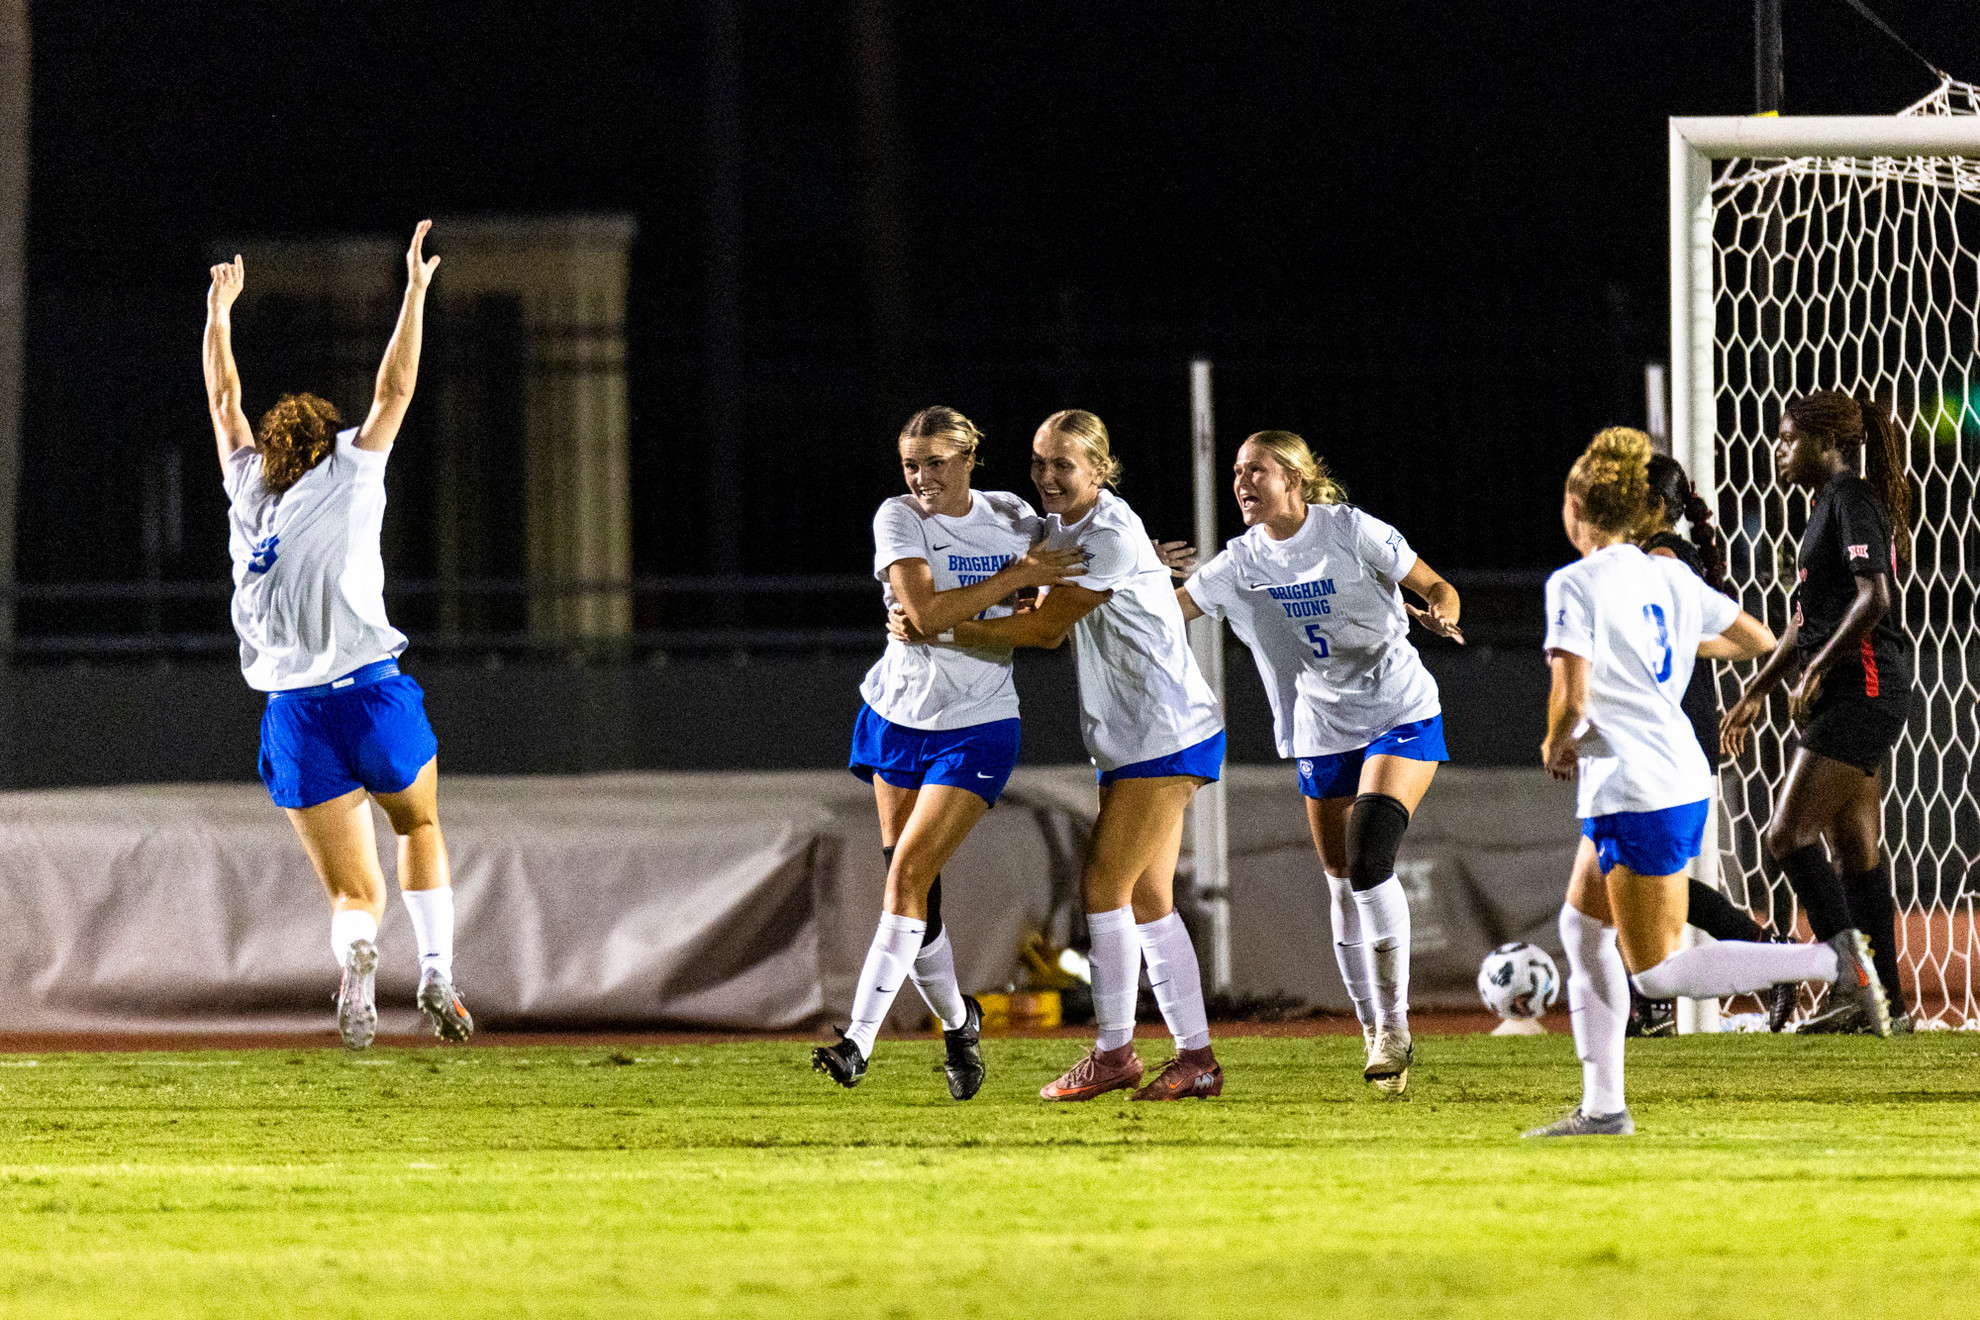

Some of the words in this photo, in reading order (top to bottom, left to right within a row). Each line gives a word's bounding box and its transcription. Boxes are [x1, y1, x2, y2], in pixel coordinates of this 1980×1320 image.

[1267, 578, 1337, 600] BRIGHAM
[1282, 599, 1331, 618] YOUNG
[1304, 624, 1329, 658] 5
[1642, 603, 1672, 683] 3
